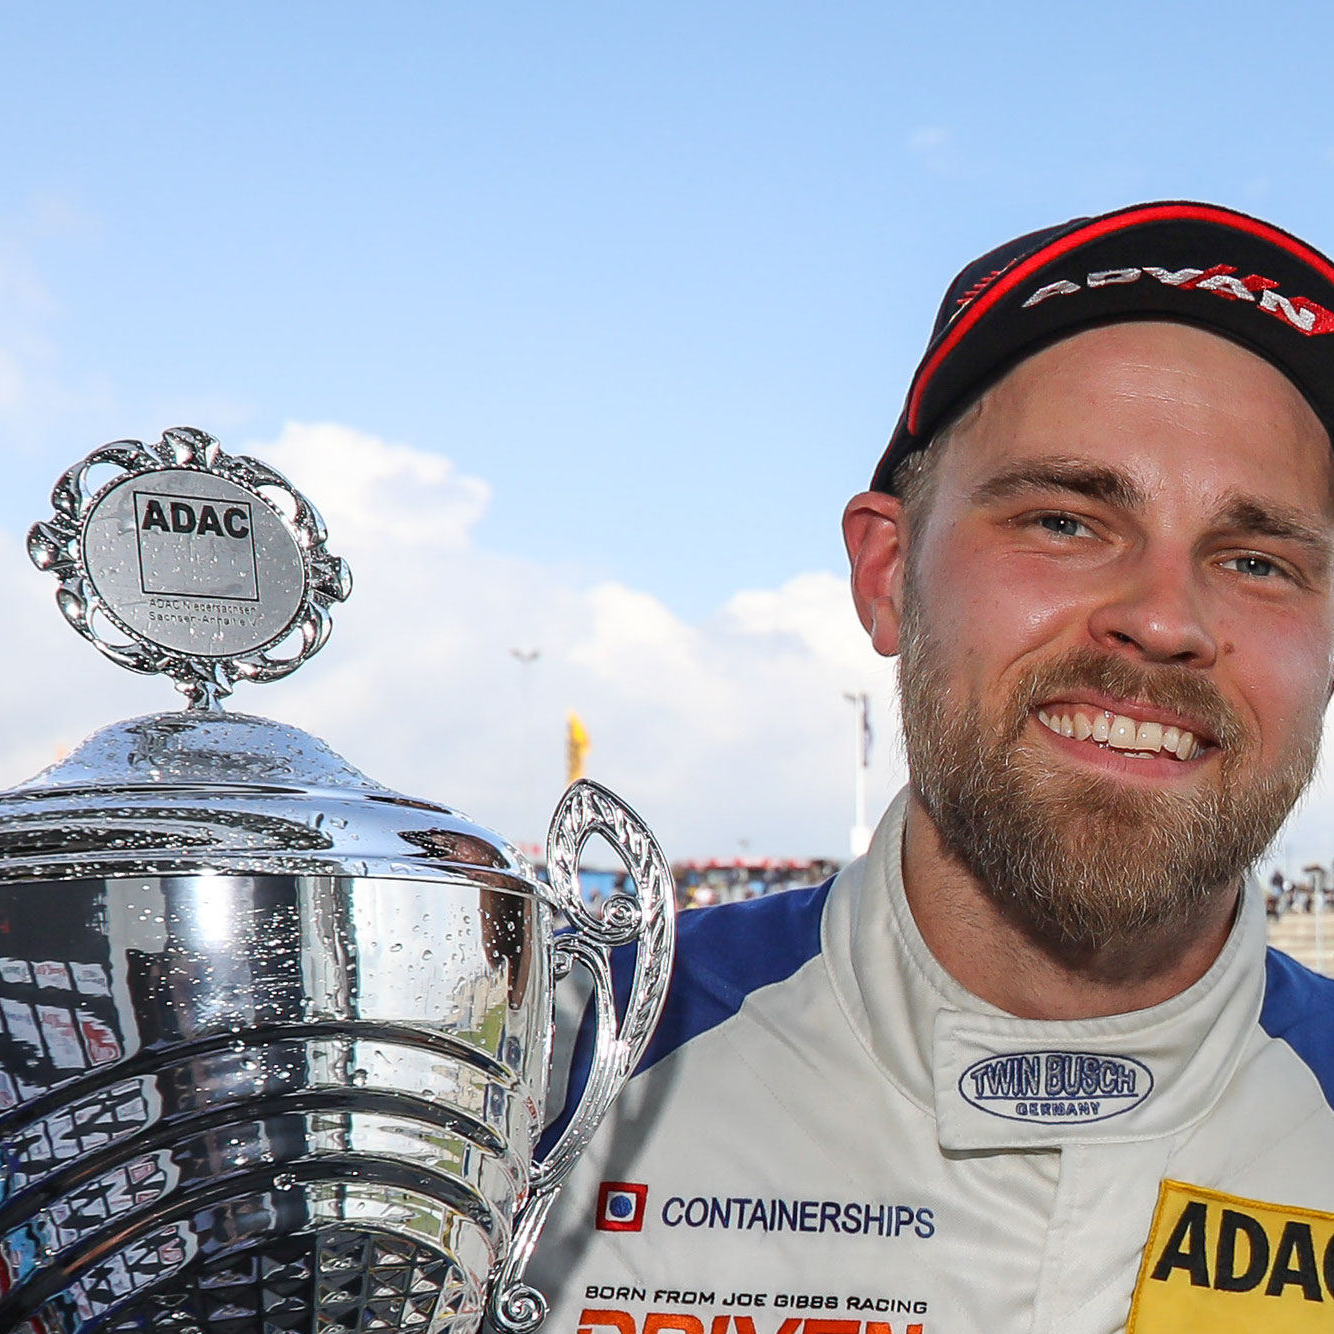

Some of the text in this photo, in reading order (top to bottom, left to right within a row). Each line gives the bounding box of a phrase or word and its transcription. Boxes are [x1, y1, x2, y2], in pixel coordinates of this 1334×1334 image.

[1022, 266, 1316, 331] ADVAN
[141, 499, 249, 540] ADAC
[149, 599, 180, 610] ADAC
[970, 1054, 1137, 1098] TWIN BUSCH
[1015, 1101, 1101, 1117] GERMANY
[661, 1196, 936, 1239] CONTAINERSHIPS
[585, 1285, 928, 1315] BORN FROM JOE GIBBS RACING
